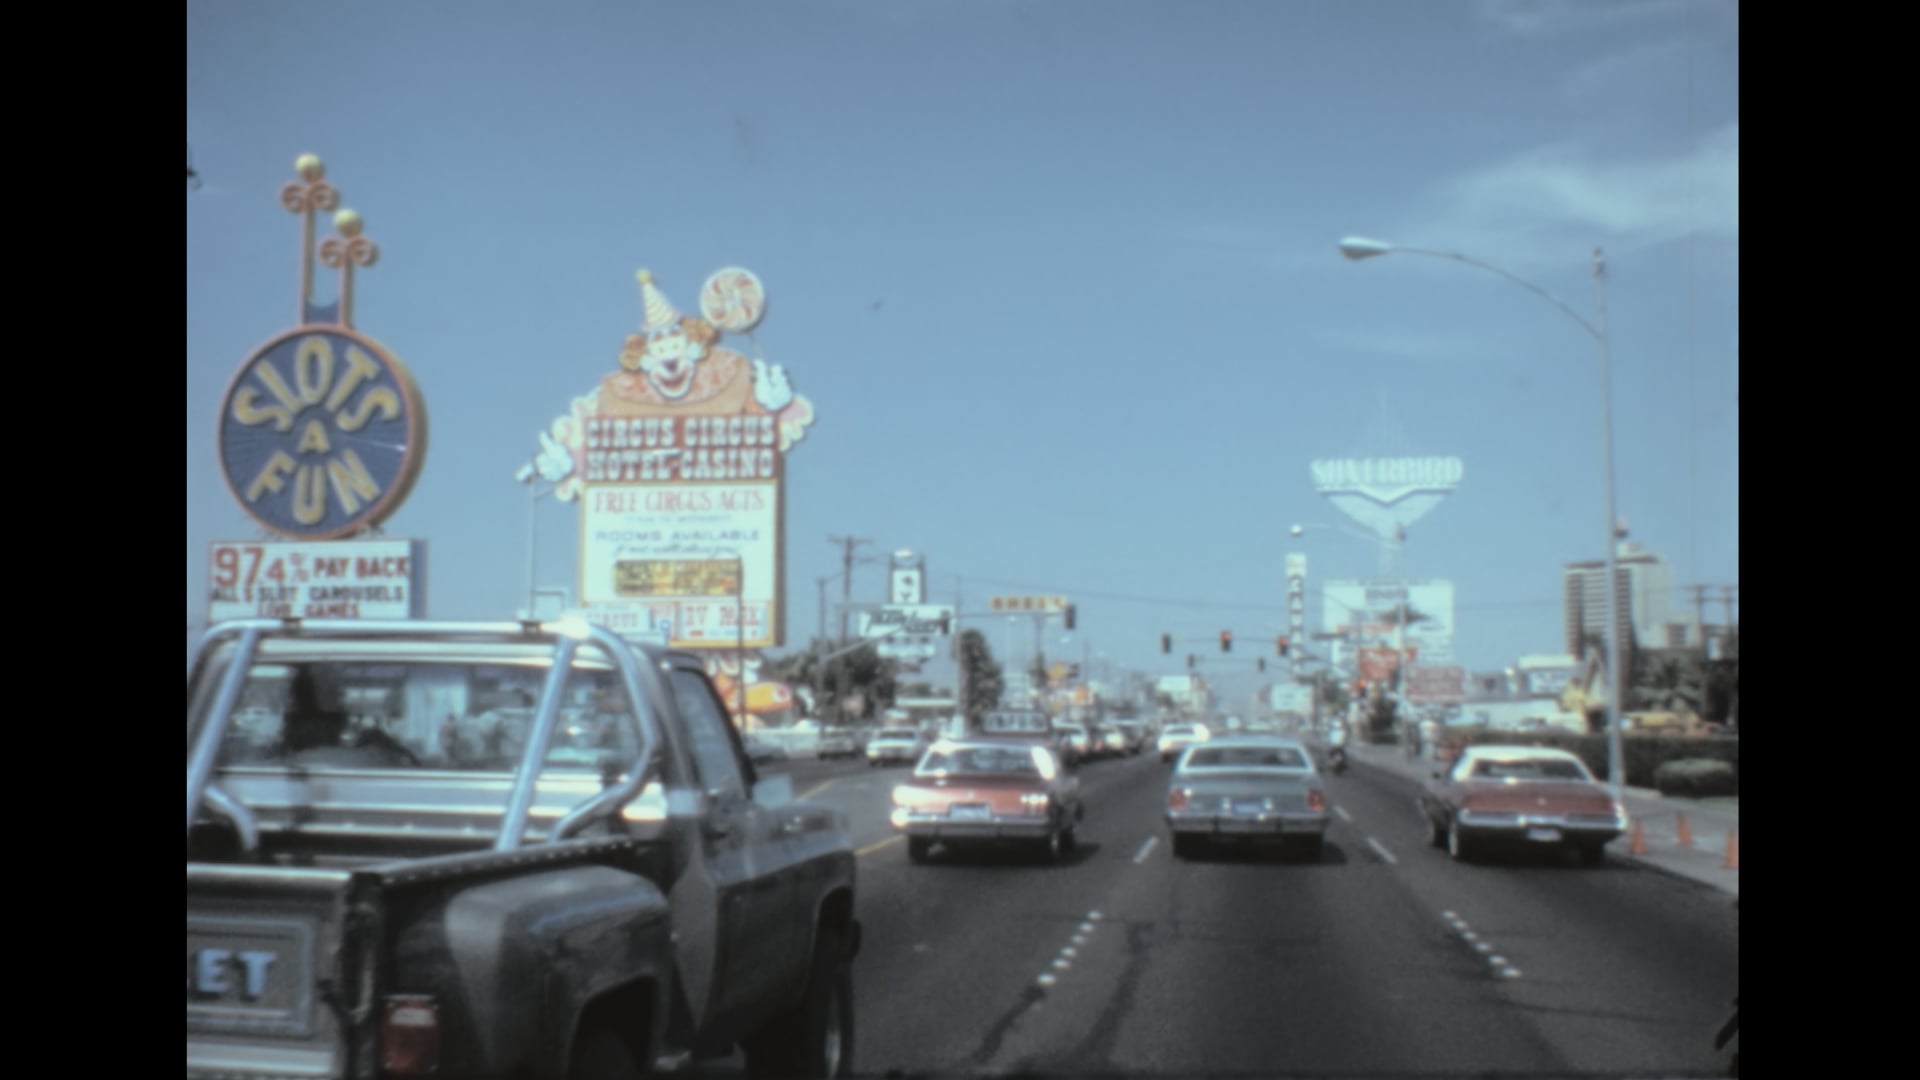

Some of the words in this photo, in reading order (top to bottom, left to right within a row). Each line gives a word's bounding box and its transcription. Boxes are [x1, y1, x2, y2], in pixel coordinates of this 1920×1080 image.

[232, 335, 400, 432] SLOTS
[299, 419, 331, 453] A
[587, 416, 675, 448] CIRCUS
[684, 414, 775, 447] CIRCUS
[586, 451, 671, 480] HOTEL
[680, 447, 774, 479] CASINO
[1310, 456, 1464, 485] SILVERBIRD
[246, 449, 381, 525] FUN
[594, 490, 638, 514] FREE
[645, 488, 712, 512] CIRCUS
[720, 487, 765, 512] ACTS
[595, 529, 662, 542] ROOMS
[671, 529, 759, 542] AVAILABLE
[314, 556, 351, 578] PAY
[356, 555, 411, 578] BACK
[305, 602, 361, 618] GAMES
